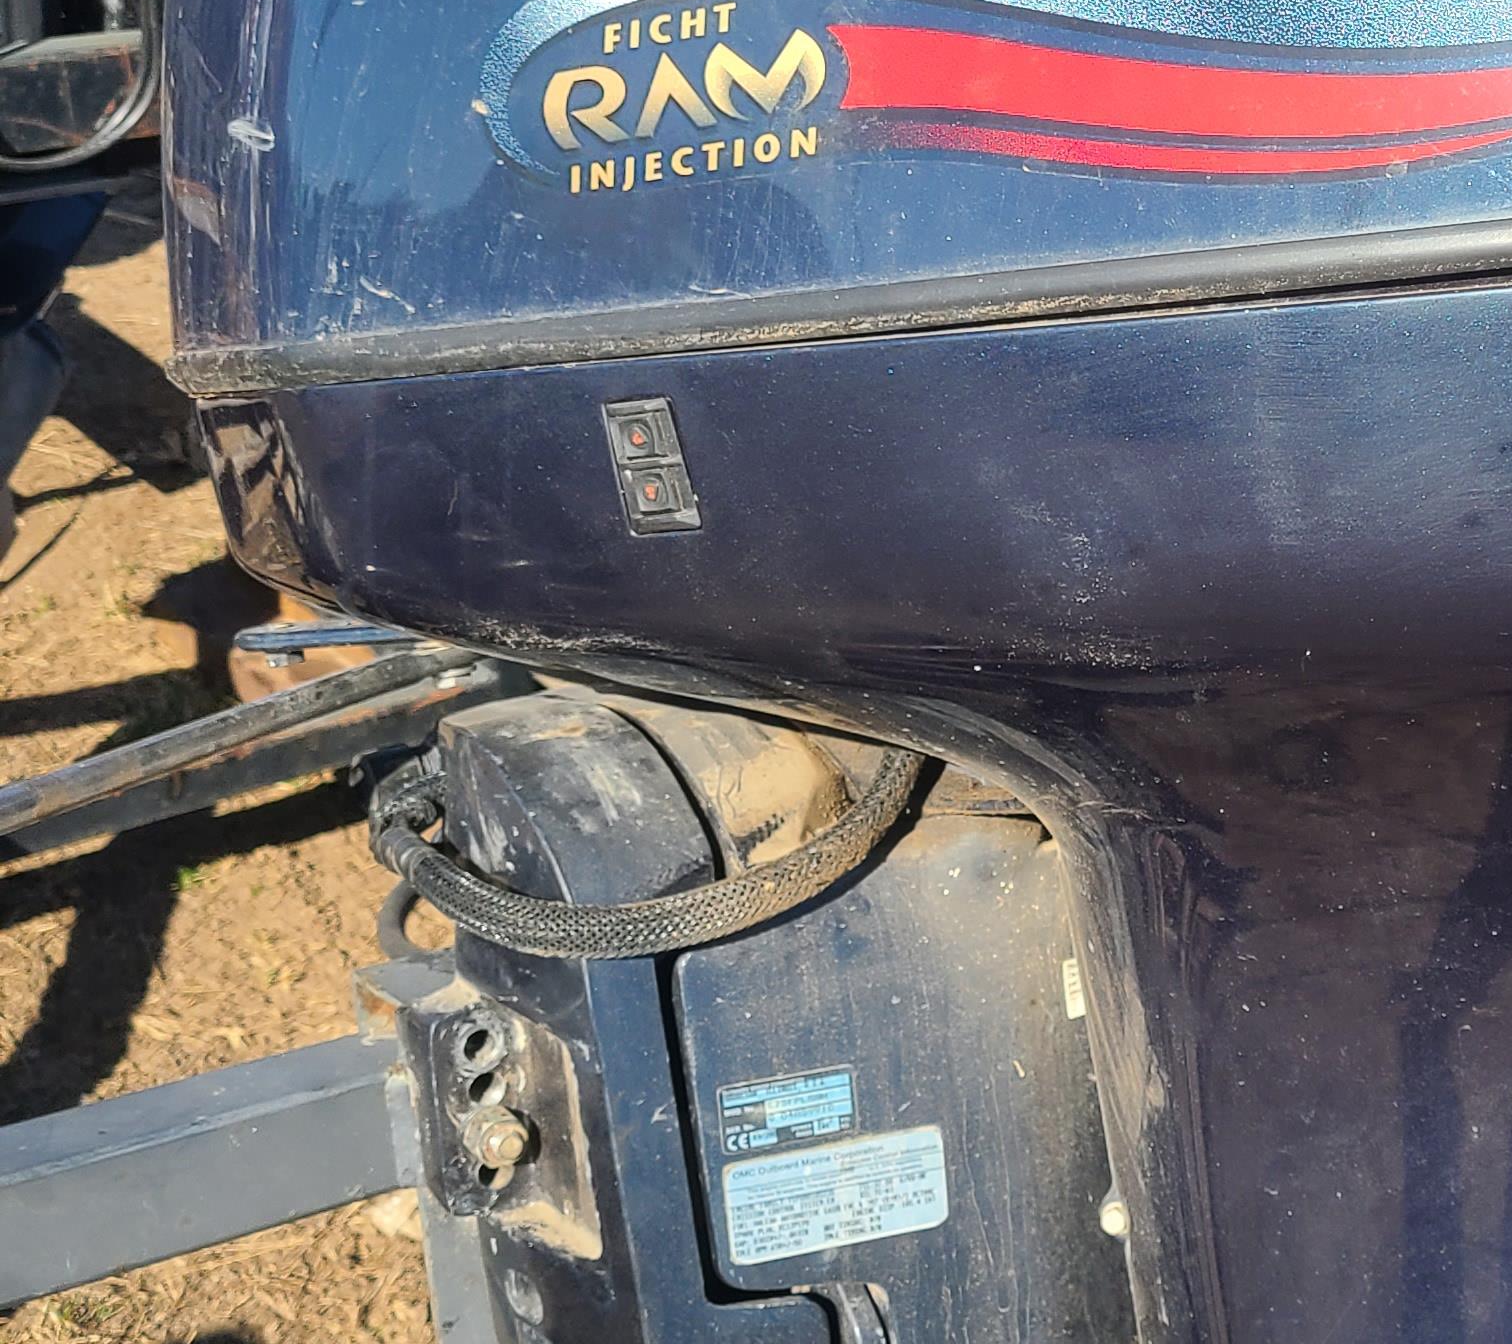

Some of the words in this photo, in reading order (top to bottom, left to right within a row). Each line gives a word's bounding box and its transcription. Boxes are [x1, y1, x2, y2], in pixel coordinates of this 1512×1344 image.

[603, 2, 737, 54] FICHT
[543, 28, 827, 150] RAM
[570, 126, 817, 194] INJECTION
